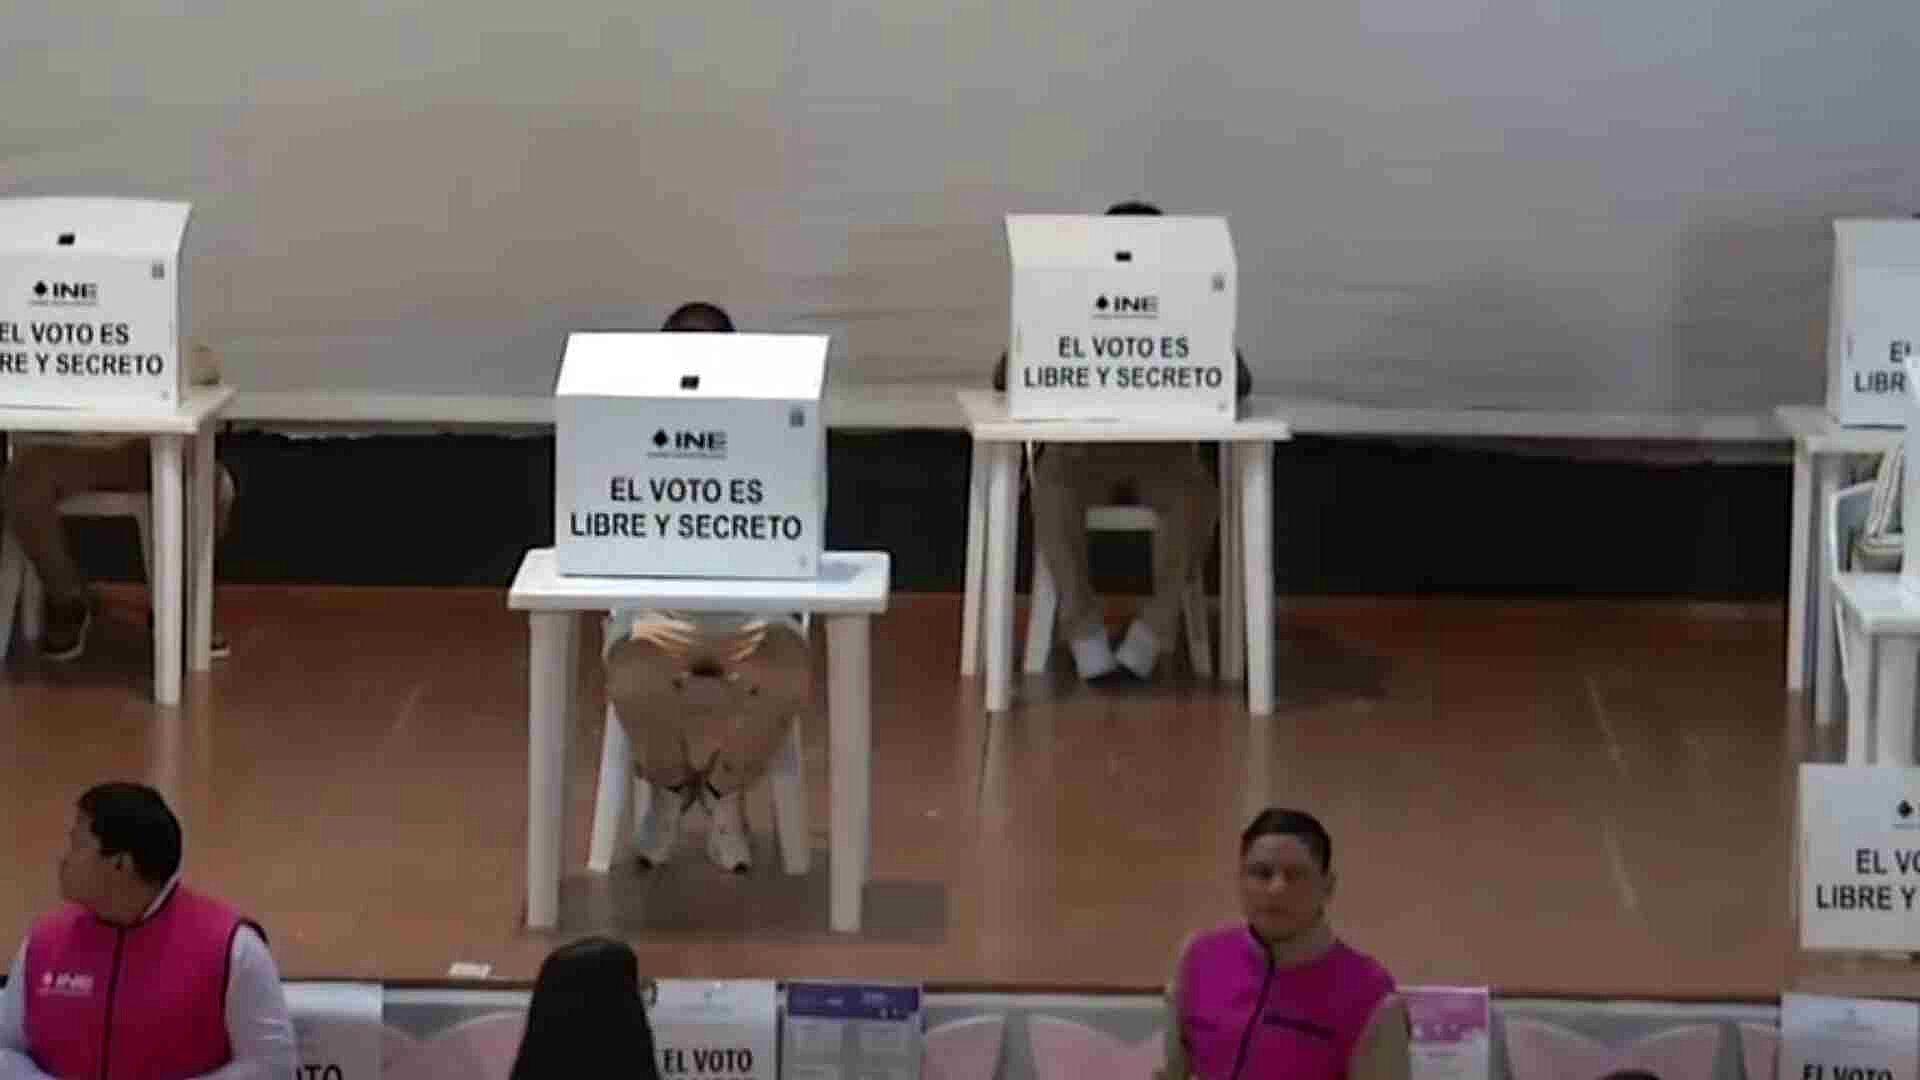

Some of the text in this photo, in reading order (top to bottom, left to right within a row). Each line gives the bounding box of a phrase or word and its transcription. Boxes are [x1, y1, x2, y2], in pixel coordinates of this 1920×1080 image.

[53, 282, 97, 299] INE
[1114, 295, 1158, 312] INE
[0, 322, 129, 345] EL VOTO ES
[1058, 336, 1189, 358] EL VOTO ES
[35, 352, 50, 374] Y
[56, 353, 164, 376] SECRETO
[1024, 366, 1223, 388] LIBRE Y SECRETO
[1854, 370, 1906, 393] LIBR
[675, 431, 727, 450] INE
[610, 477, 763, 504] EL VOTO ES
[570, 512, 802, 540] LIBRE Y SECRETO
[1857, 848, 1888, 875] EL
[1816, 884, 1916, 911] LIBRE Y
[664, 1048, 752, 1073] EL VOTO
